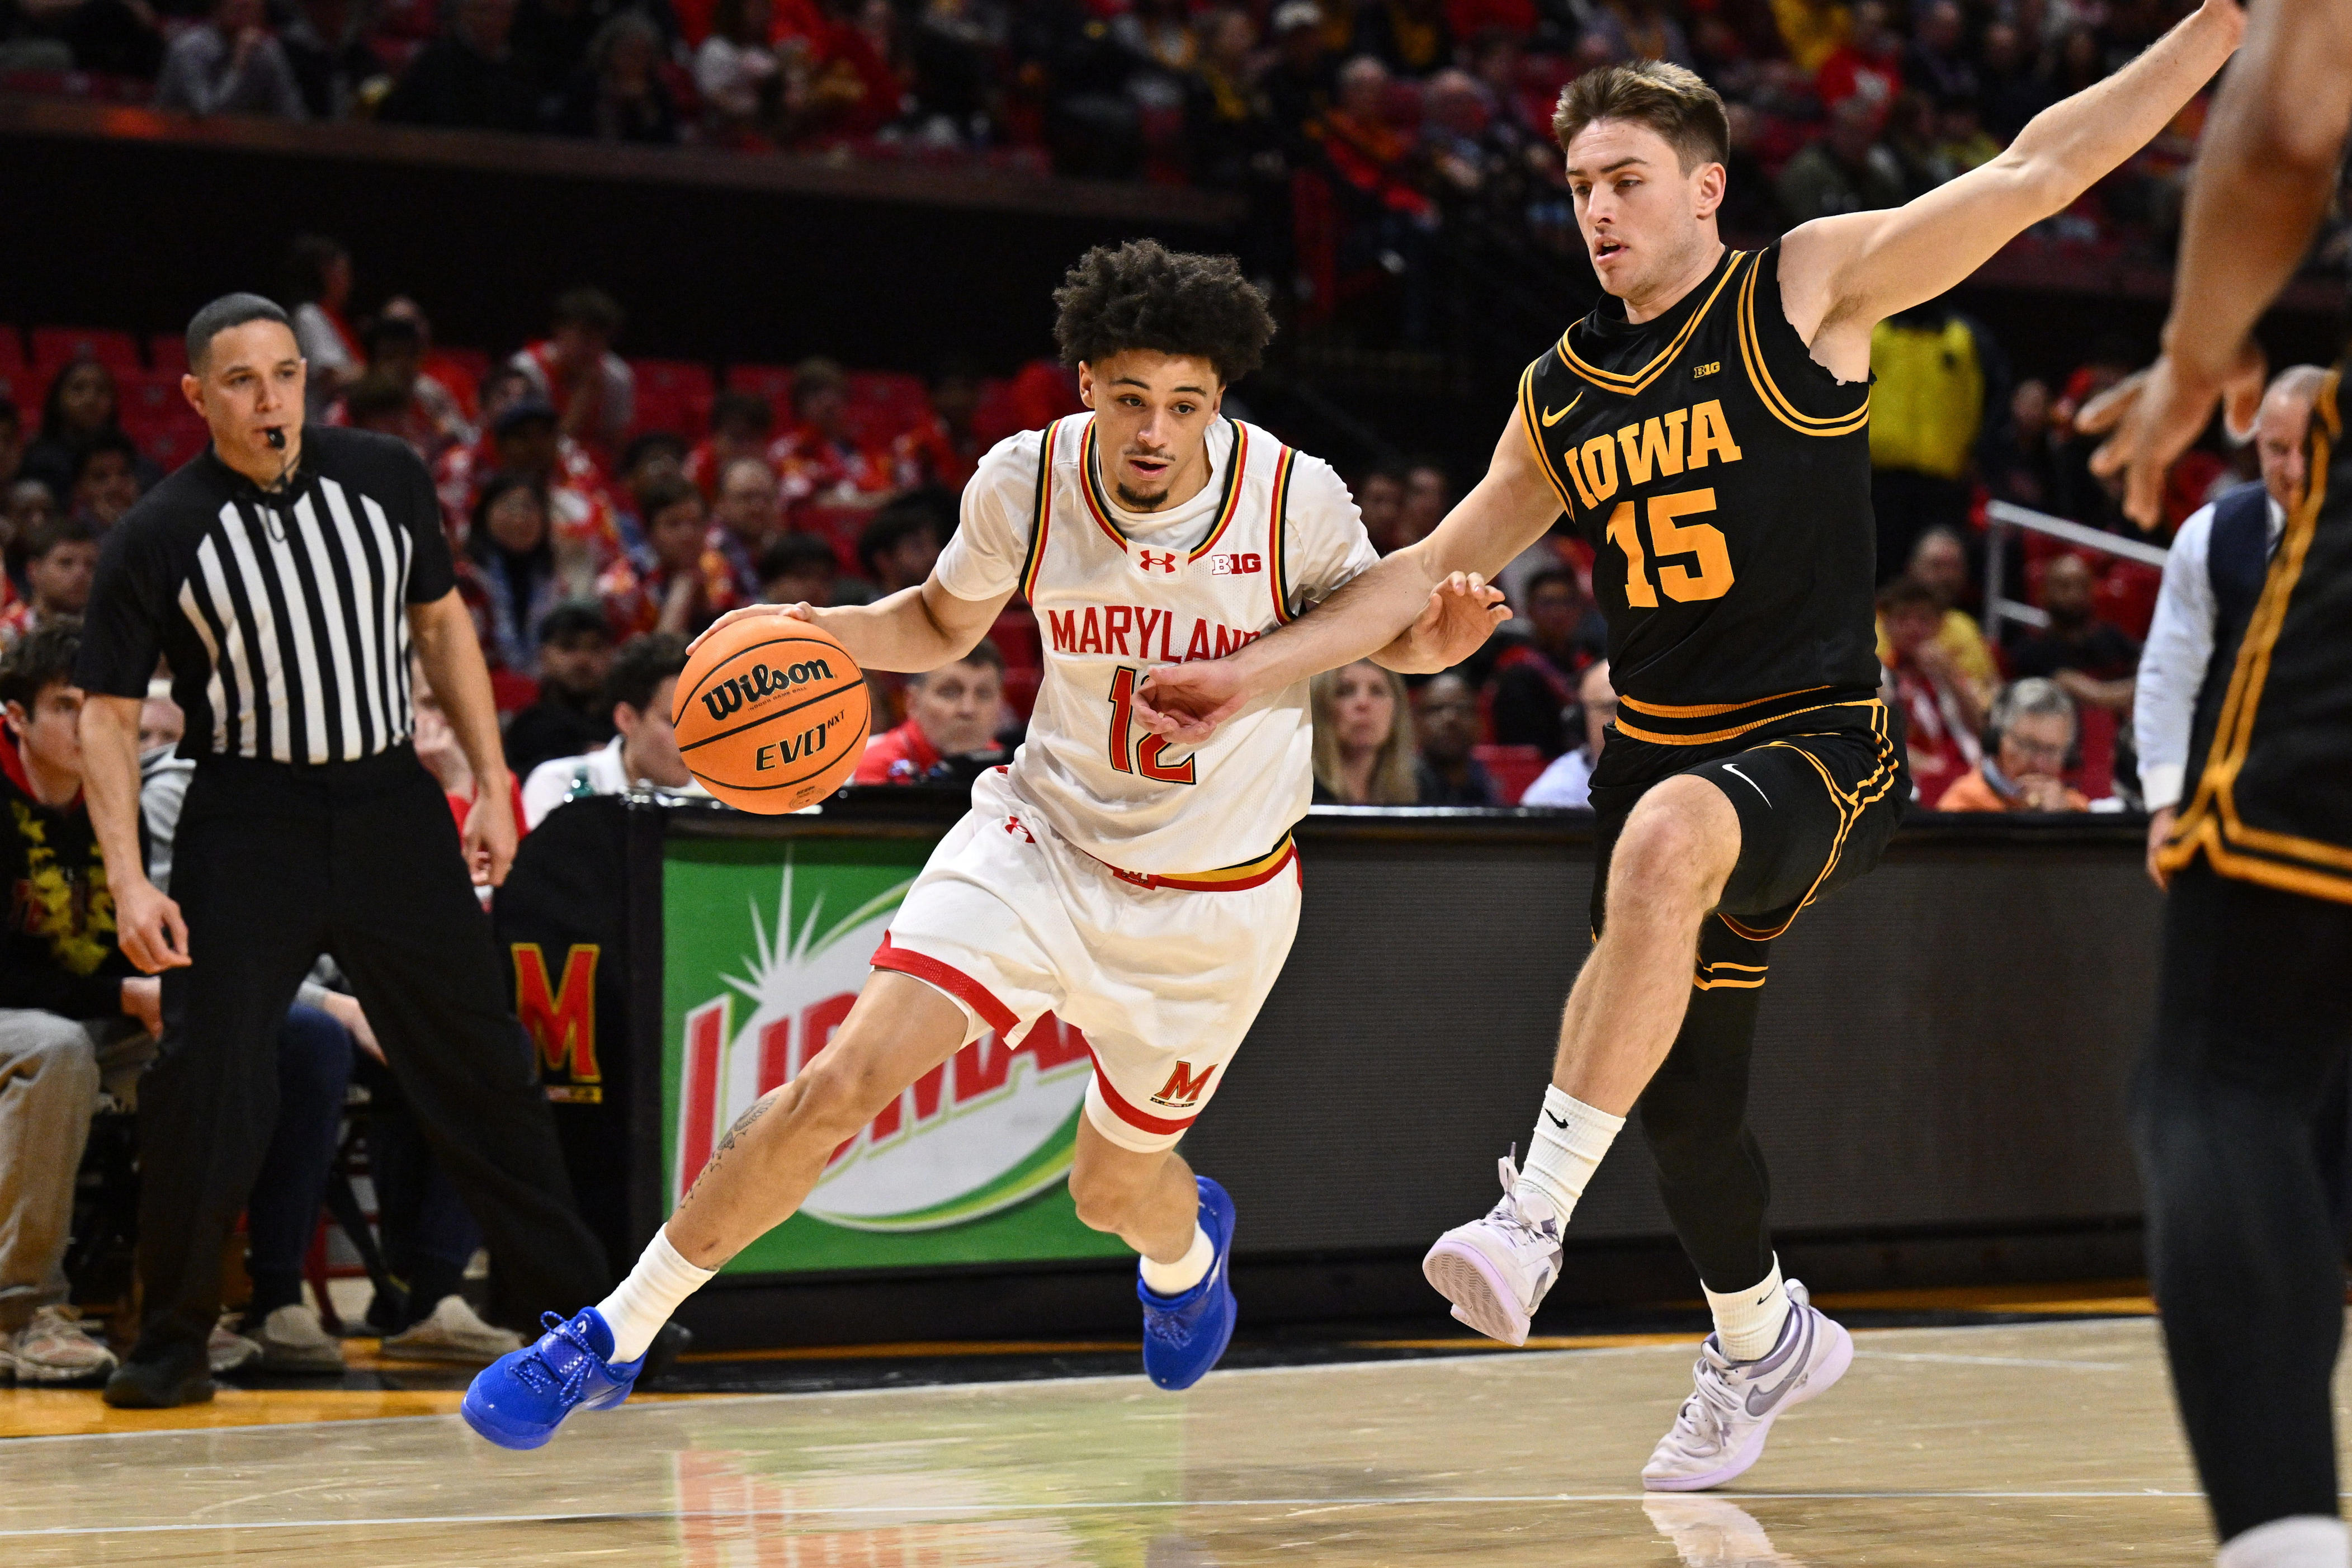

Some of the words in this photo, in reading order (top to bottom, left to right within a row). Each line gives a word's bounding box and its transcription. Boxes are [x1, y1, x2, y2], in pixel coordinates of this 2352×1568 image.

[1564, 399, 1742, 510] IOWA
[1606, 488, 1735, 608] 15
[702, 658, 834, 721] Wilson
[748, 698, 771, 711] INDOOR
[755, 722, 826, 772] EVO
[827, 709, 845, 729] NXT
[511, 942, 601, 1083] M
[1154, 1060, 1218, 1102] M
